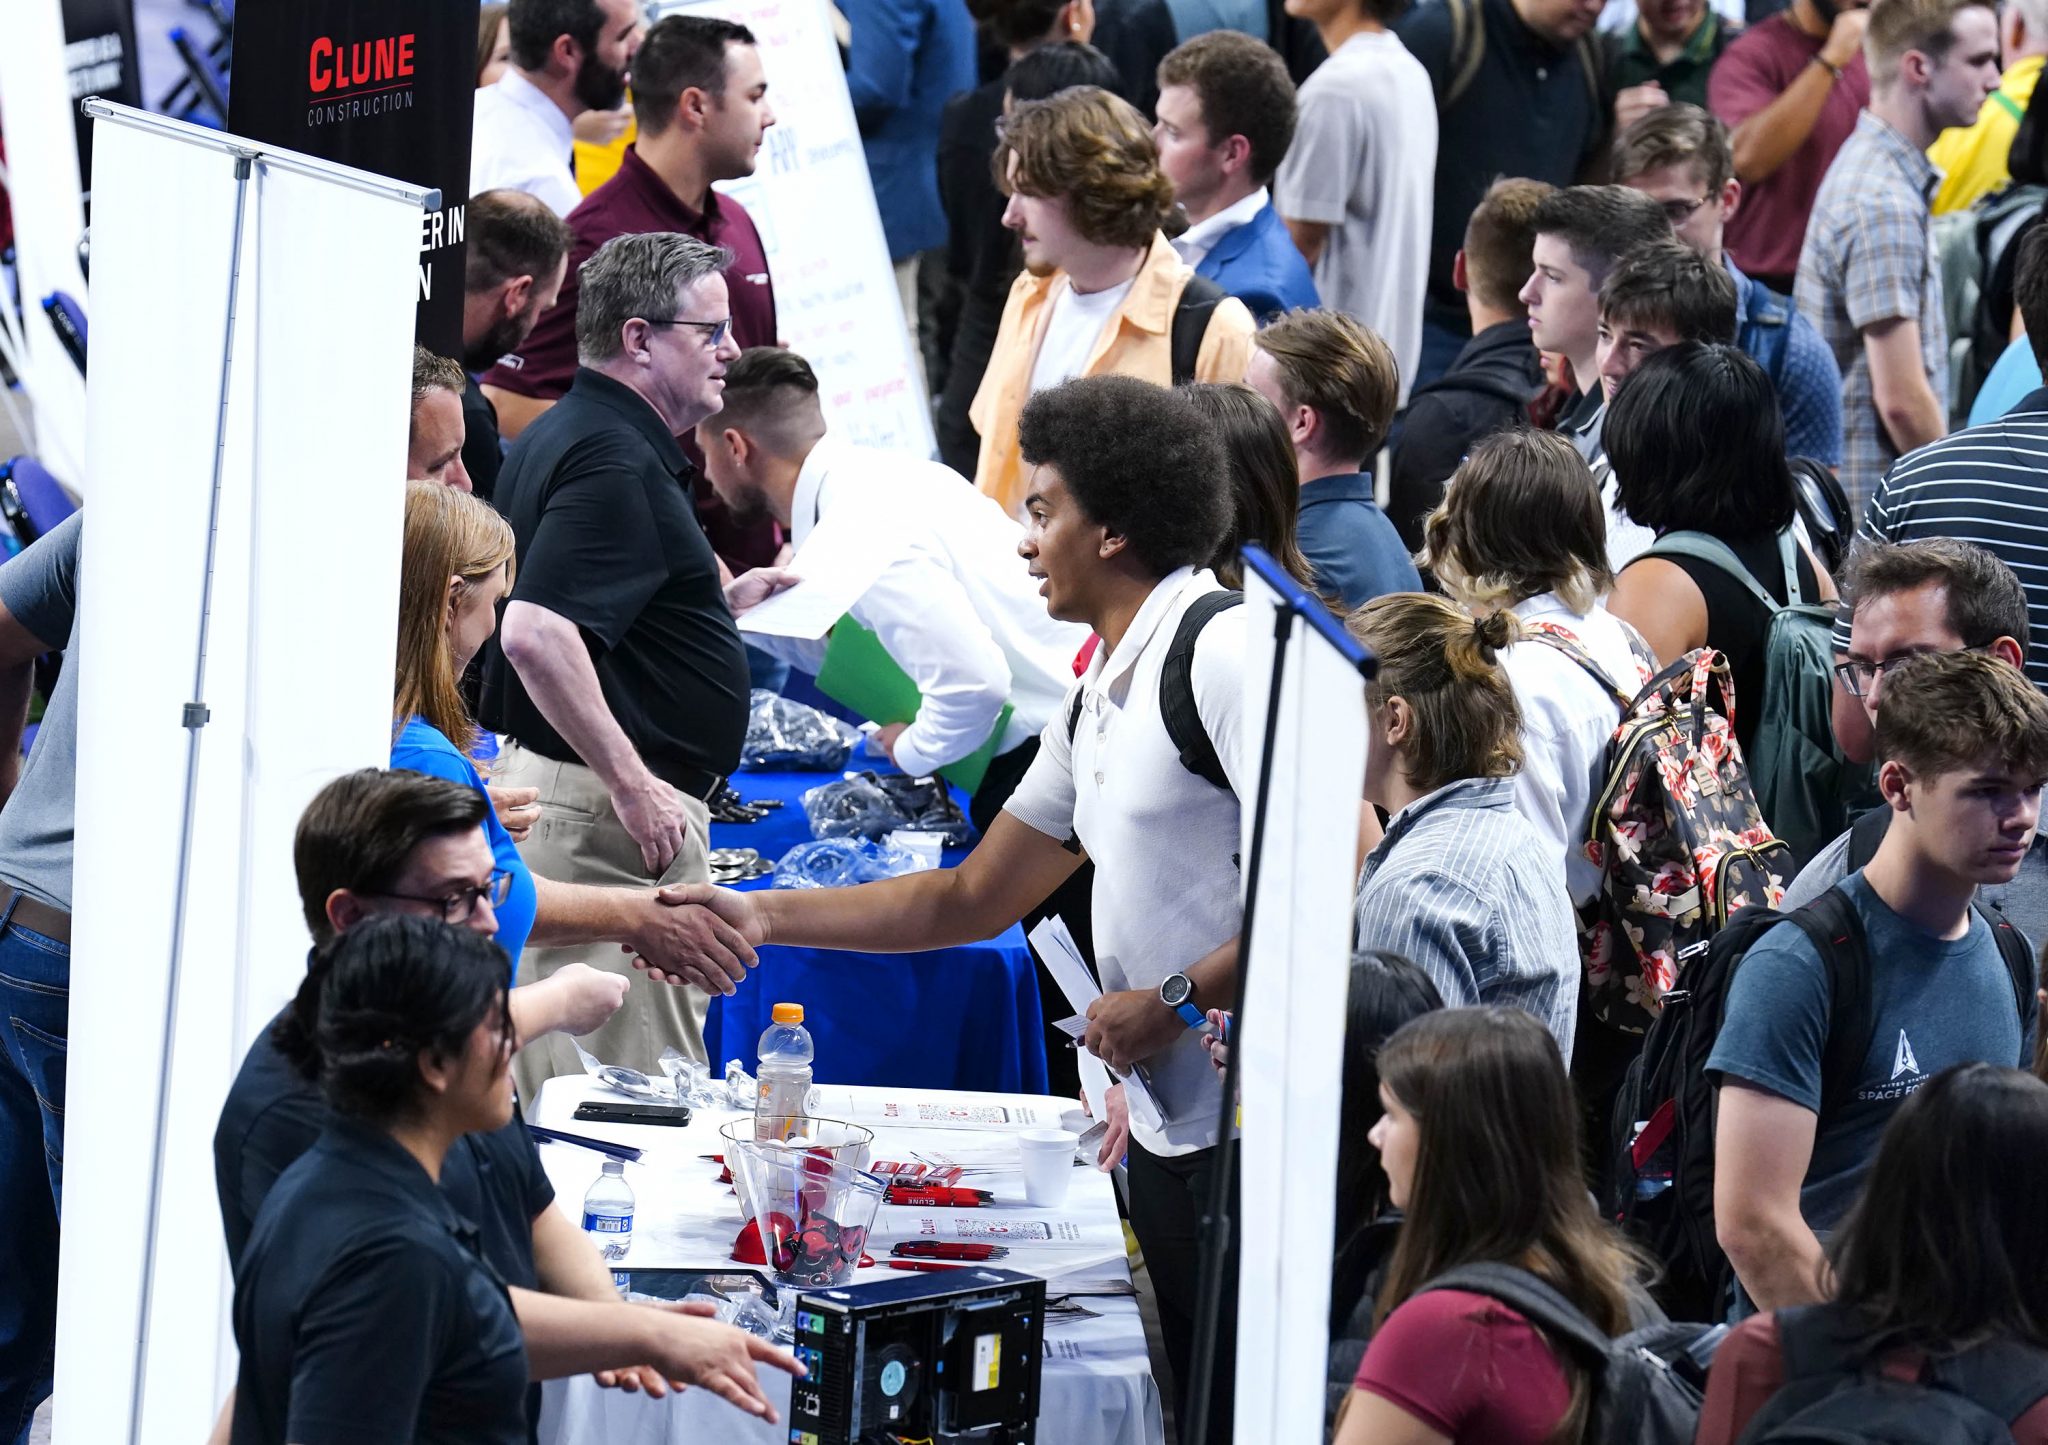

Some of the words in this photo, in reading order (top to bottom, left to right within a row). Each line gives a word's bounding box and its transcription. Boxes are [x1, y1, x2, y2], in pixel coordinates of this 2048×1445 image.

[309, 34, 415, 93] CLUNE
[308, 91, 413, 127] CONSTRUCTION
[448, 204, 465, 246] IN
[1858, 1088, 1902, 1101] SPACE
[907, 1198, 936, 1206] CLUNE
